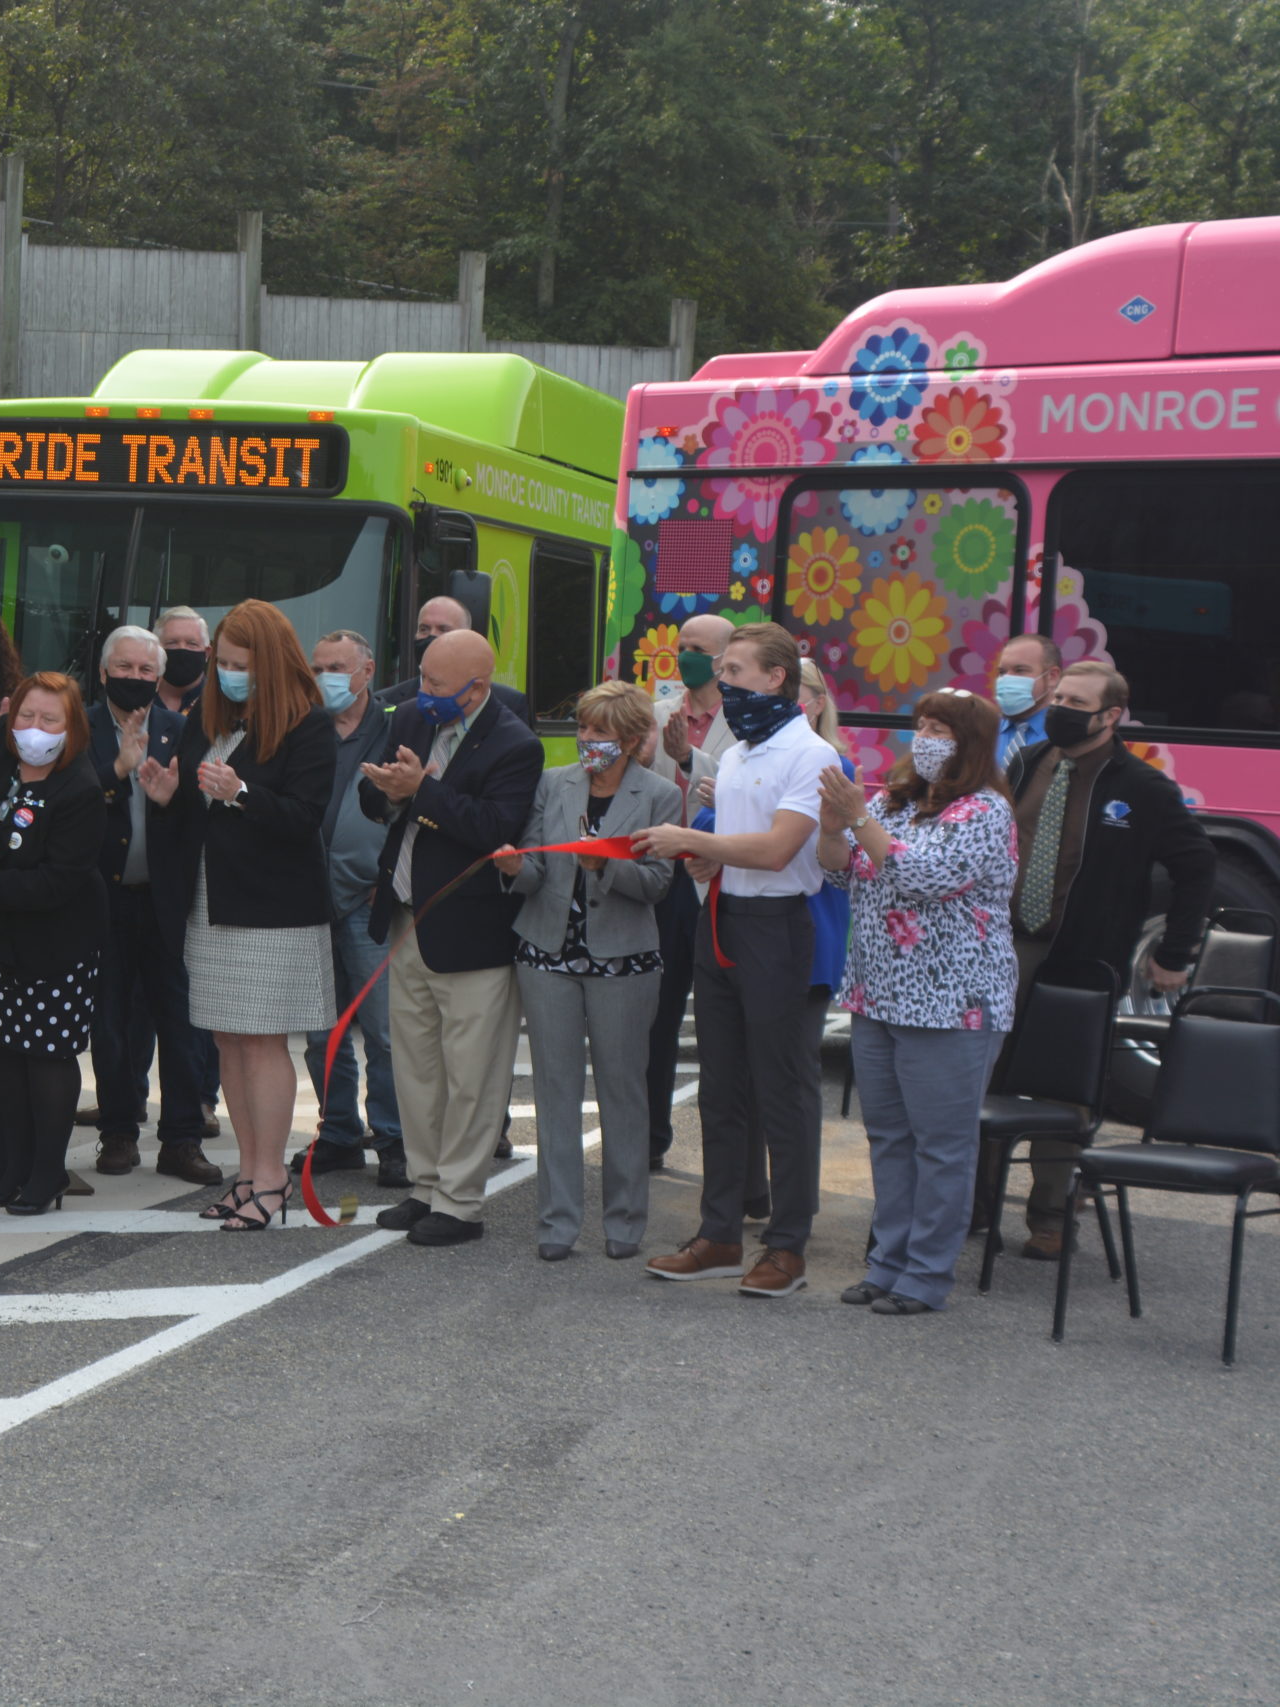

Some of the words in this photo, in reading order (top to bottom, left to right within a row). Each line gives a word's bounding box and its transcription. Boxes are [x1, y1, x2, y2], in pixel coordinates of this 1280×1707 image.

[1126, 304, 1149, 316] CNG
[1040, 388, 1260, 434] MONROE
[122, 434, 320, 488] TRANSIT
[435, 458, 453, 485] 1901
[475, 461, 526, 507] MONROE
[527, 479, 570, 518] COUNTY
[572, 493, 610, 529] TRANSIT
